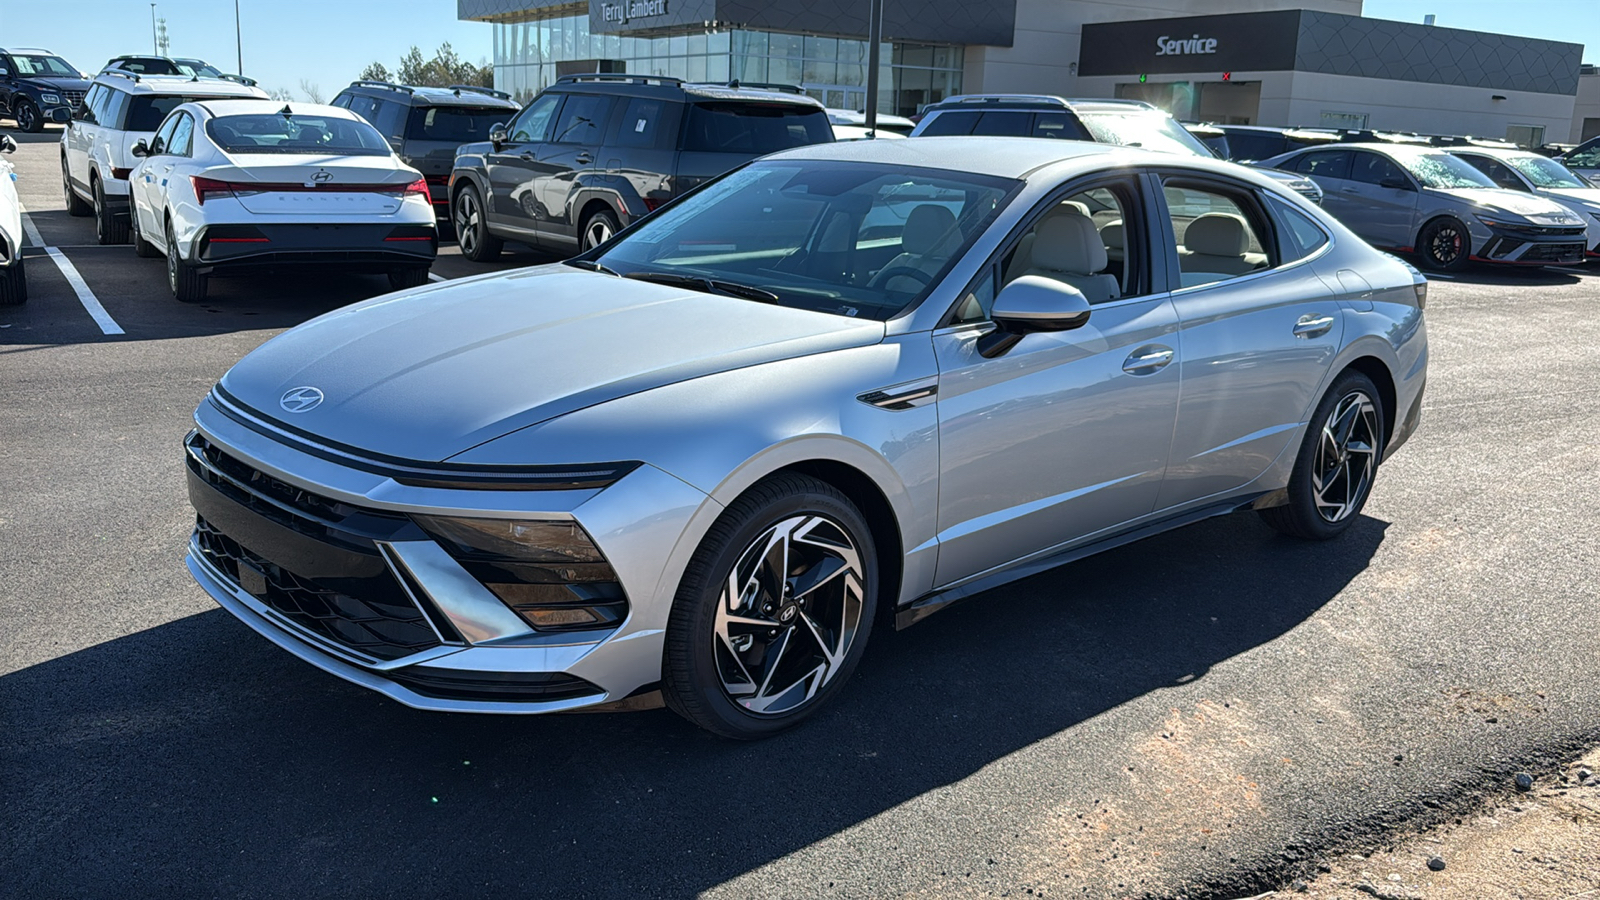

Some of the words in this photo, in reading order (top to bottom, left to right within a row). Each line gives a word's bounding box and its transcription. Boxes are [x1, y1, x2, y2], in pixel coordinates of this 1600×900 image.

[601, 3, 624, 25] Terry
[625, 0, 667, 19] Lambert
[1156, 34, 1217, 56] Service
